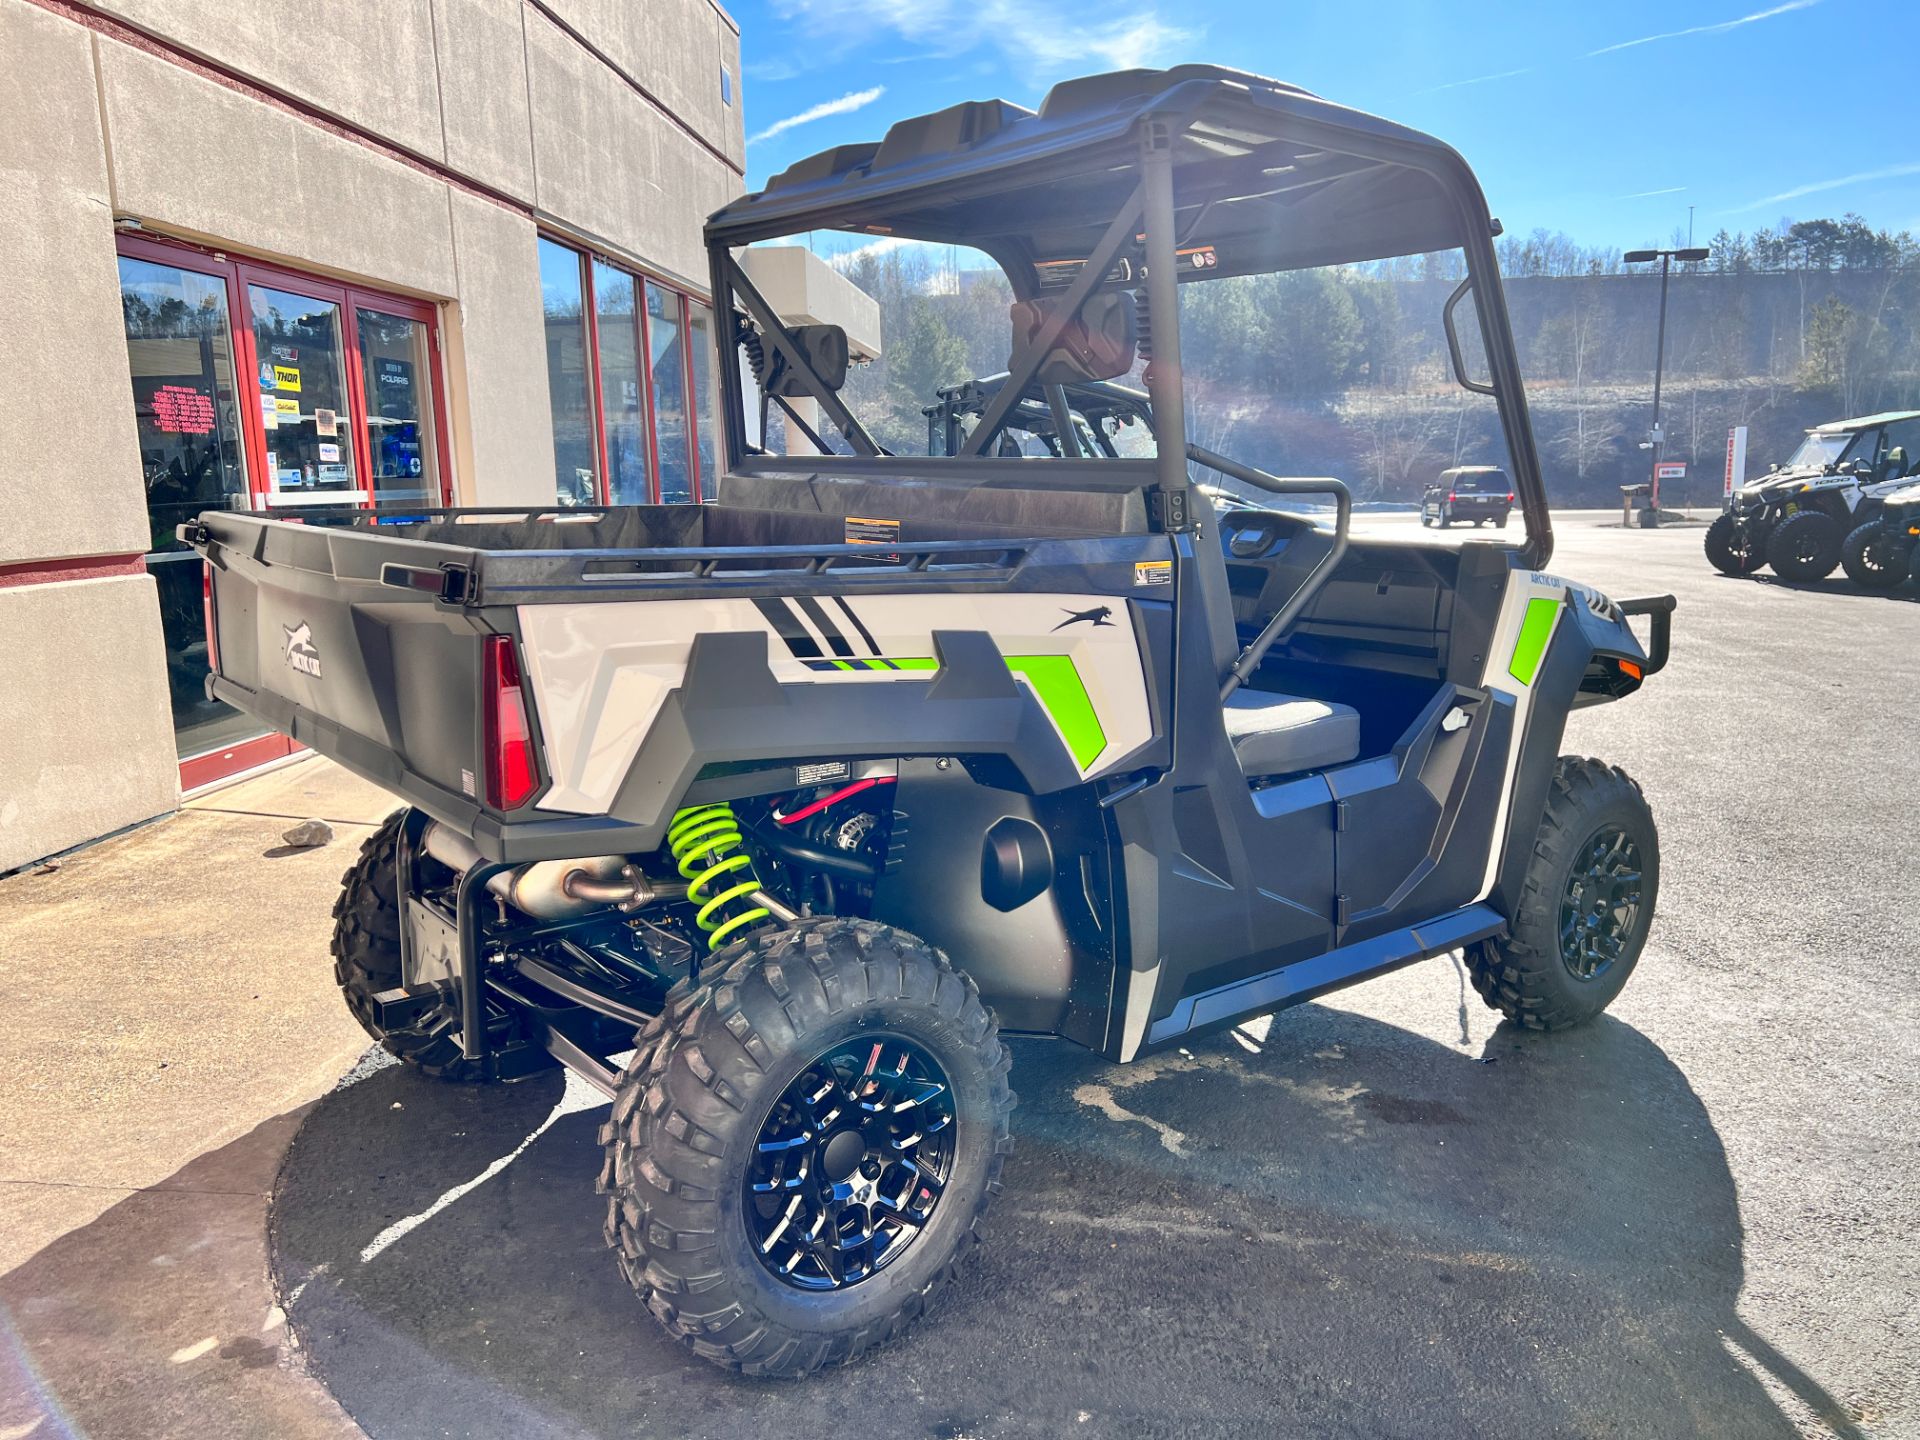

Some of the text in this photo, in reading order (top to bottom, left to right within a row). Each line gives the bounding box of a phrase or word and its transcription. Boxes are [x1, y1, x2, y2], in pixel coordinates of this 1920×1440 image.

[277, 371, 298, 383] THOR
[381, 374, 409, 385] POLARIS
[1815, 477, 1851, 486] 1000
[1530, 573, 1561, 588] ARCTIC CAT
[291, 650, 321, 677] ARCTIC CAT
